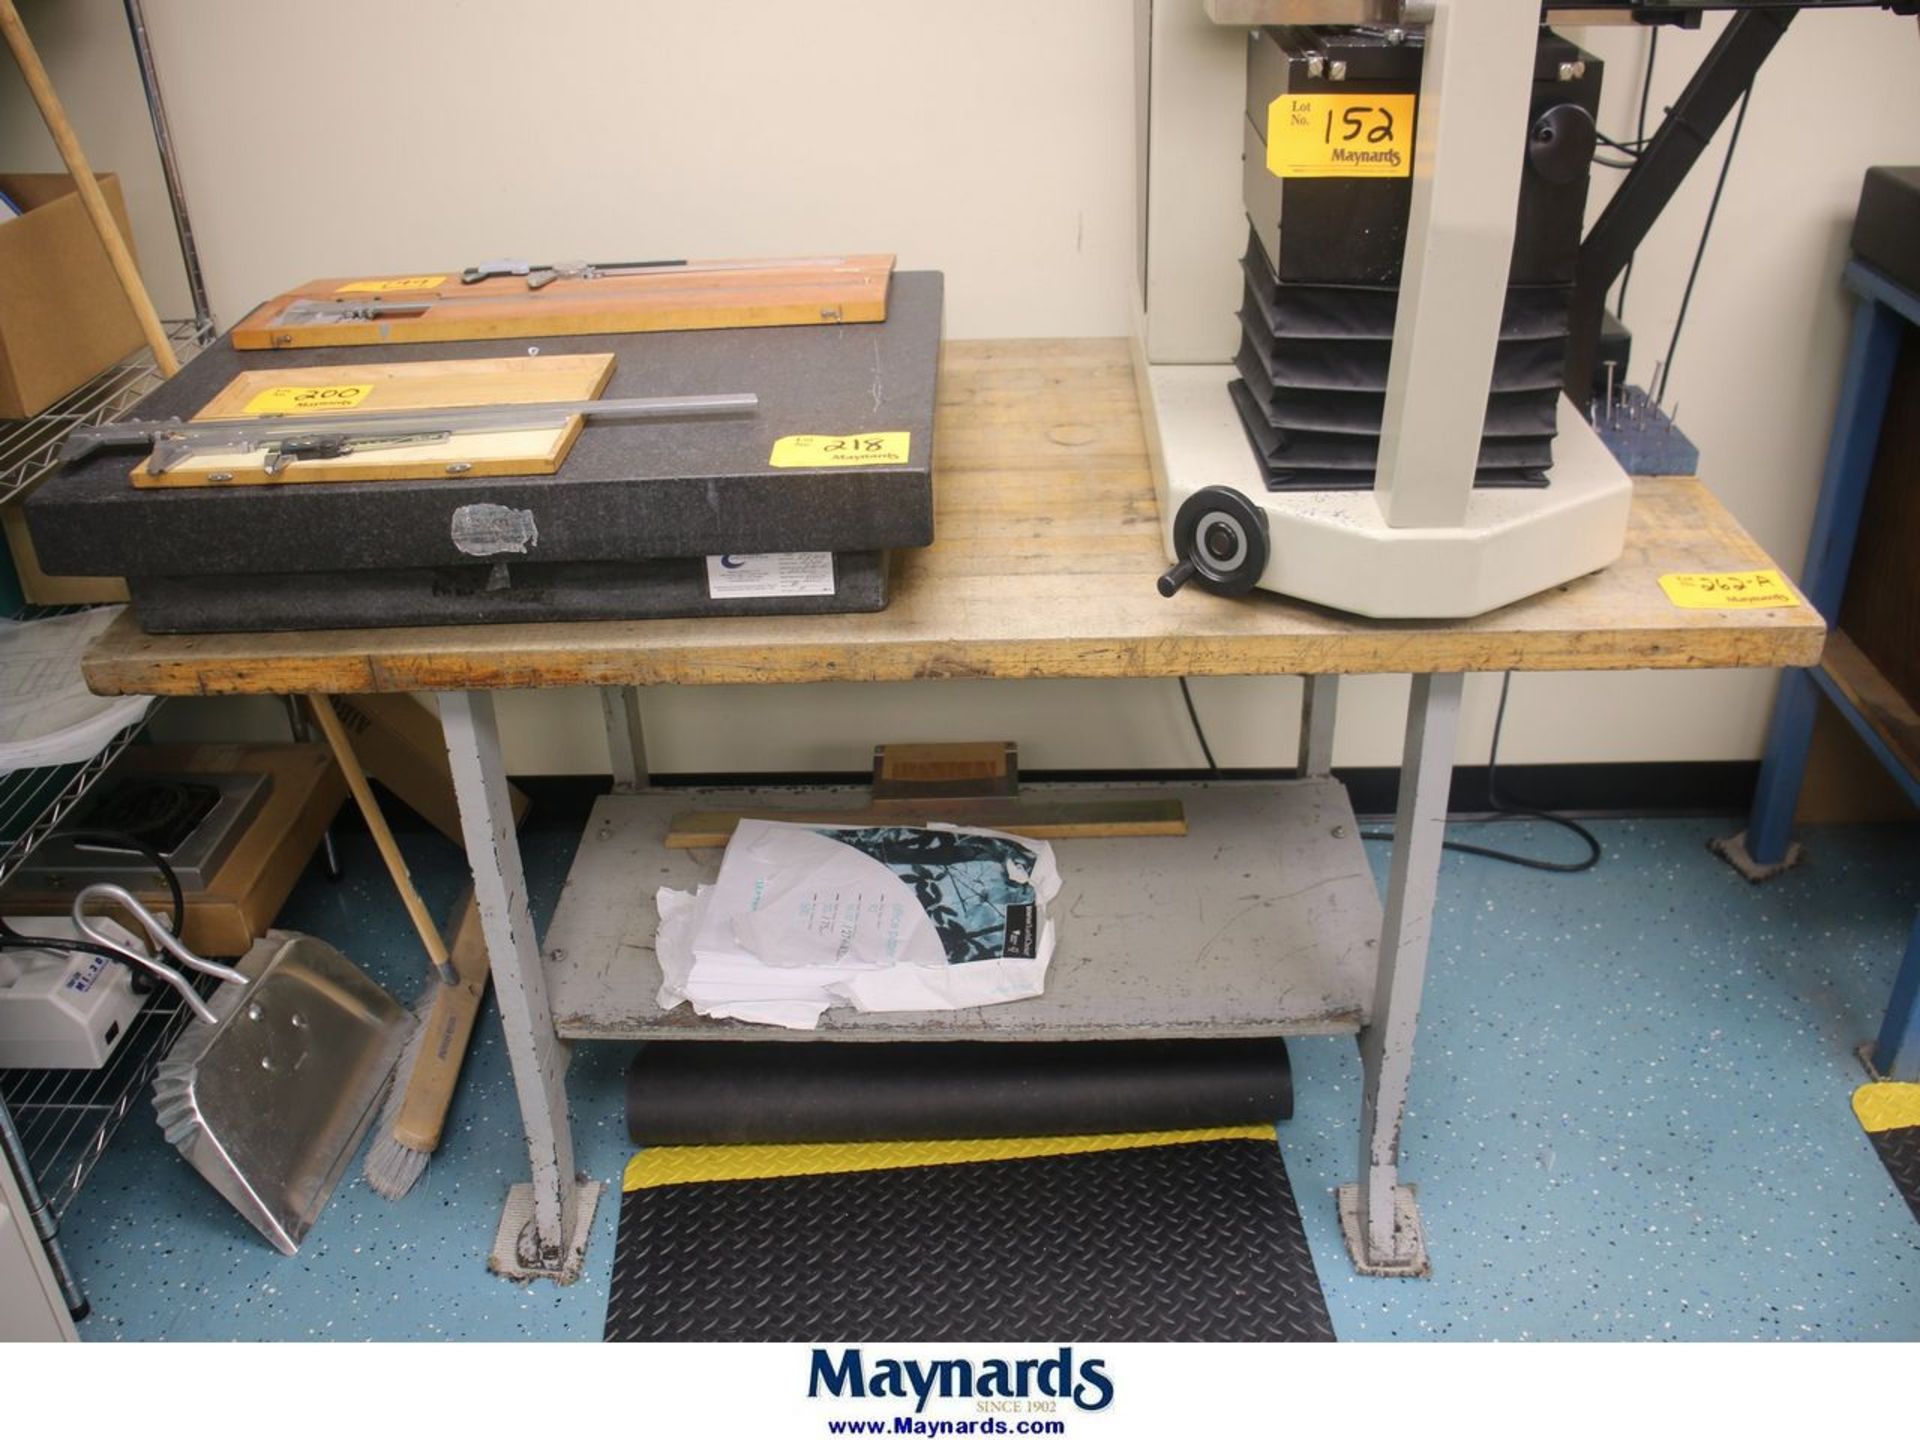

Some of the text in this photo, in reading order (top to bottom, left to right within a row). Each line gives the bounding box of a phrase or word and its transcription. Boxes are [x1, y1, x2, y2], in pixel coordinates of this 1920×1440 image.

[1291, 100, 1311, 112] Lot
[1290, 114, 1310, 126] No.
[1325, 106, 1394, 145] 152
[1331, 148, 1402, 167] Maynards
[294, 387, 360, 401] 200
[824, 438, 885, 452] 218
[832, 452, 900, 461] Maynards
[1700, 575, 1775, 591] 262-A
